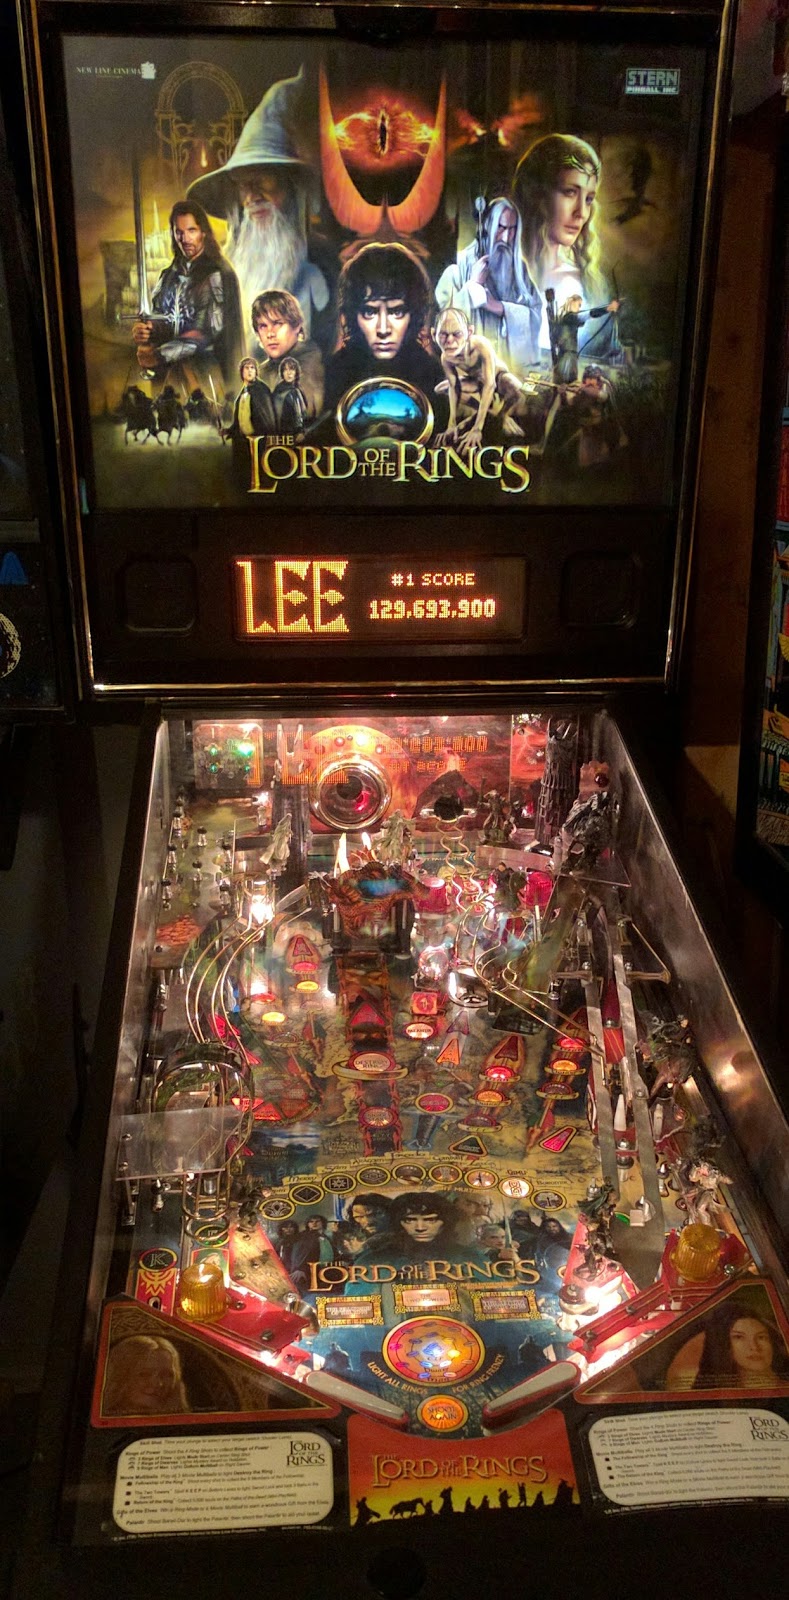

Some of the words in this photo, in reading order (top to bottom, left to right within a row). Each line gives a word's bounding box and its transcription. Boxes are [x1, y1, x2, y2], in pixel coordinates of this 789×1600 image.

[76, 66, 92, 74] NEW
[94, 66, 110, 74] LINE
[113, 67, 142, 75] CINEMA
[628, 70, 678, 86] STERN
[267, 435, 294, 446] THE
[246, 435, 358, 494] LORD
[364, 448, 390, 463] OF
[358, 462, 396, 477] THE
[392, 440, 530, 494] RINGS
[391, 573, 414, 586] #1
[421, 573, 476, 586] SCORE
[236, 561, 350, 633] LEE
[369, 599, 496, 620] 129,693,900
[308, 1261, 397, 1292] LORD
[402, 1264, 424, 1272] OF
[400, 1271, 429, 1280] THE
[424, 1260, 540, 1284] RINGS
[367, 1362, 387, 1381] LIGHT
[384, 1376, 400, 1388] ALL
[401, 1384, 428, 1395] RINGS
[452, 1384, 470, 1394] FOR
[470, 1373, 490, 1388] RING
[486, 1354, 506, 1377] FRENZY
[428, 1406, 457, 1414] SHOOT
[430, 1414, 458, 1422] AGAIN
[749, 1416, 780, 1430] LORD
[750, 1430, 789, 1440] RINGS
[290, 1441, 321, 1455] LORD
[286, 1454, 326, 1466] RINGS
[372, 1454, 438, 1488] LORD
[460, 1454, 548, 1484] RINGS
